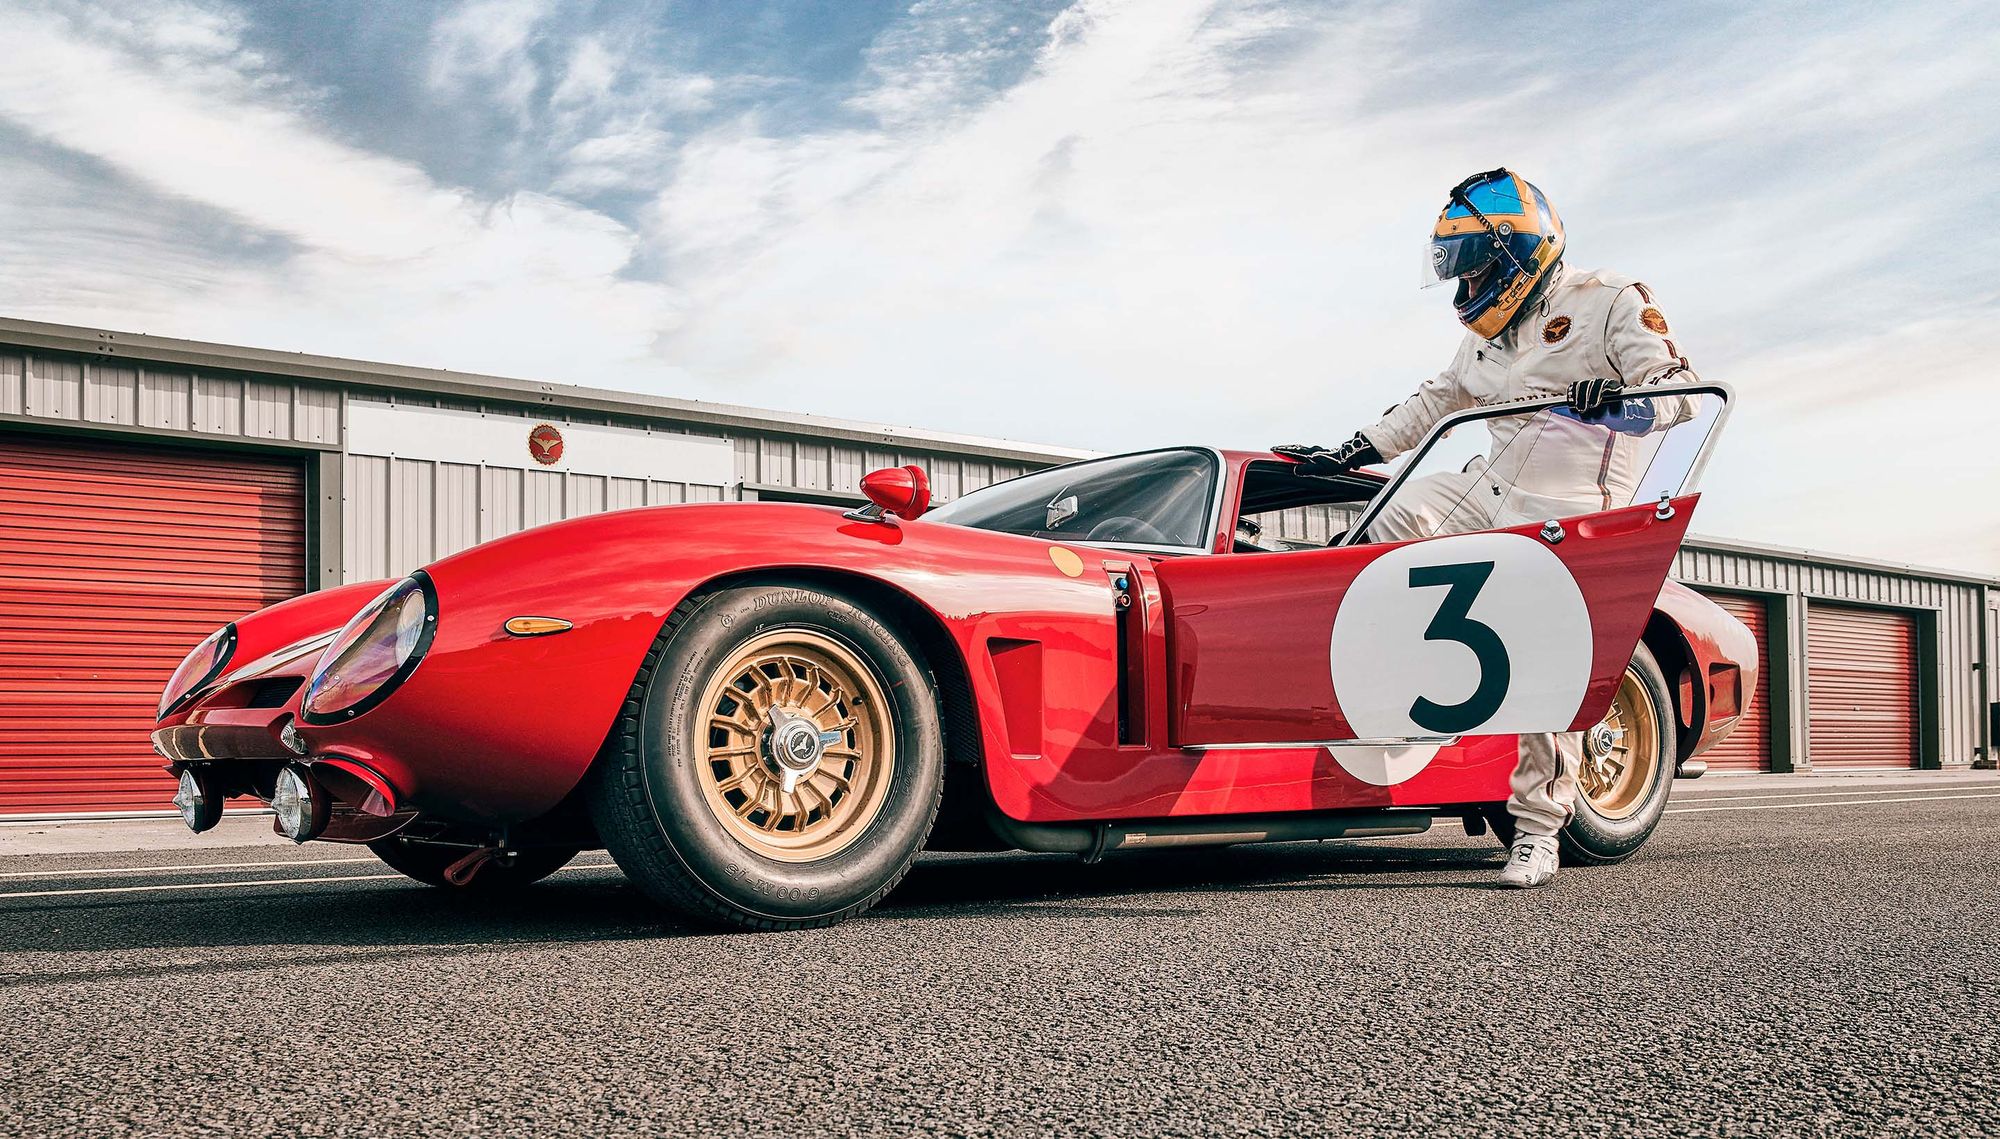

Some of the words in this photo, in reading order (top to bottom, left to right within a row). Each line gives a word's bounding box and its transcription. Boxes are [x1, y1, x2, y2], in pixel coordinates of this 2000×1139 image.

[753, 589, 834, 612] DUNLOP
[848, 605, 910, 668] RACING
[1408, 560, 1512, 734] 3
